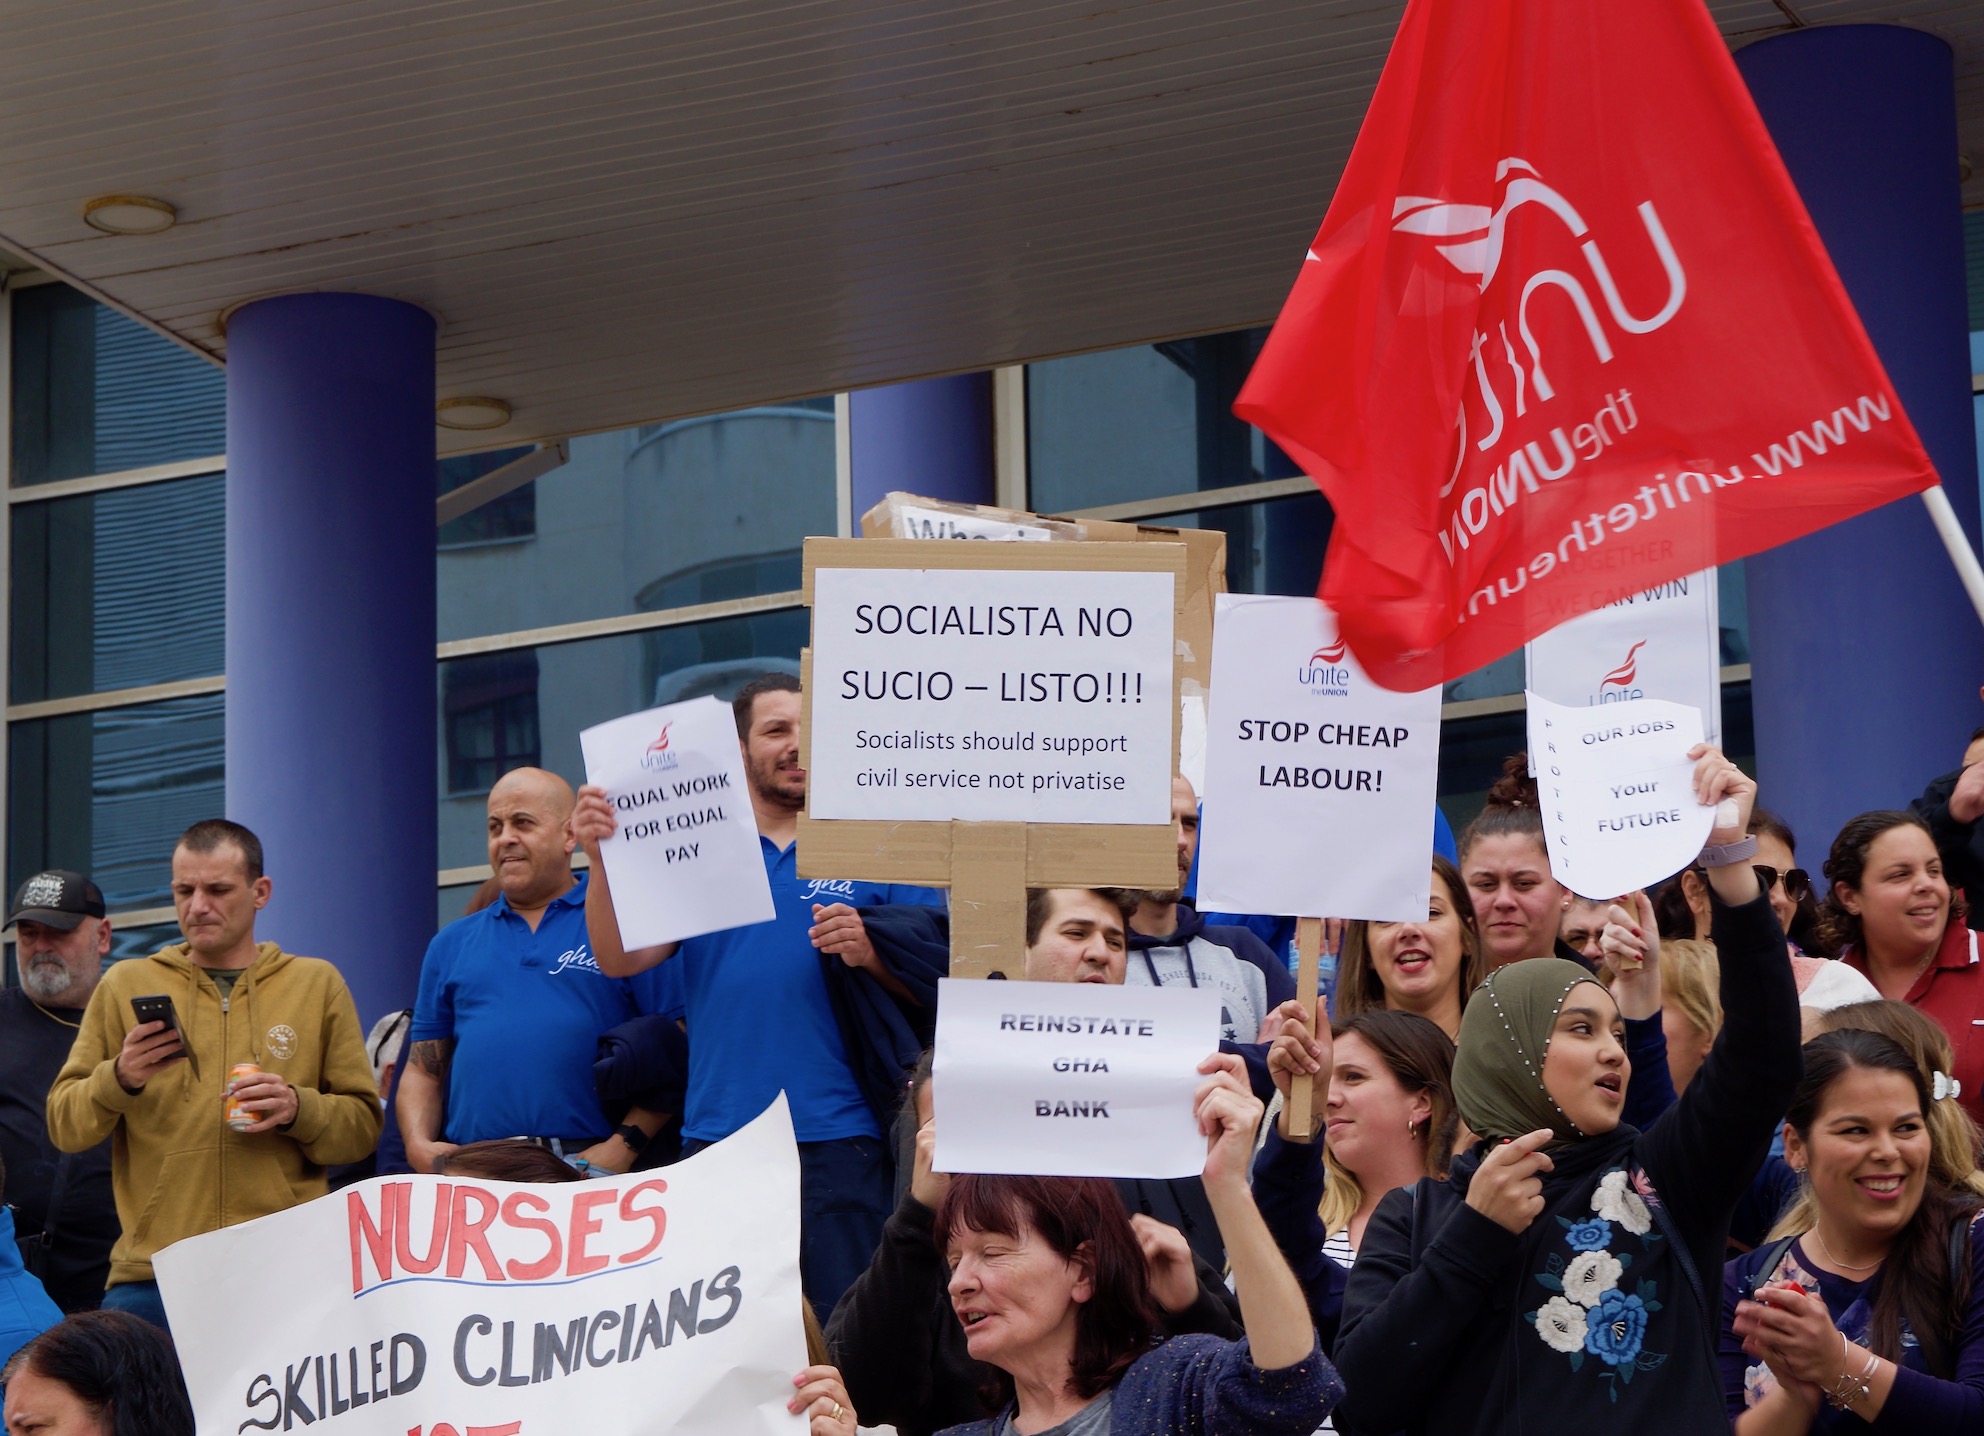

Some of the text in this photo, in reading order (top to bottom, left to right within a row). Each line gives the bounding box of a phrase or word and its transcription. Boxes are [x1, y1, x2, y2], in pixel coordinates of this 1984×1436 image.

[907, 517, 989, 540] Wh
[1641, 576, 1688, 602] WIN
[855, 604, 1133, 638] SOCIALISTA NO
[841, 670, 953, 701] SUCIO
[1001, 672, 1142, 704] LISTO!!!
[855, 730, 1128, 757] Socialists should support
[1238, 719, 1409, 748] STOP CHEAP
[1582, 720, 1676, 746] OUR JOBS
[672, 772, 731, 798] WORK
[856, 767, 1126, 794] civil service not privatise
[1259, 765, 1382, 793] LABOUR!
[1610, 781, 1660, 799] Your
[624, 805, 728, 842] FOR EQUAL
[1597, 808, 1683, 833] FUTURE
[664, 842, 700, 864] PAY
[1000, 1013, 1155, 1037] REINSTATE
[1052, 1056, 1110, 1074] GHA
[1035, 1100, 1110, 1119] BANK
[347, 1178, 669, 1294] NURSES
[238, 1265, 742, 1436] SKILLED CLINICIANS
